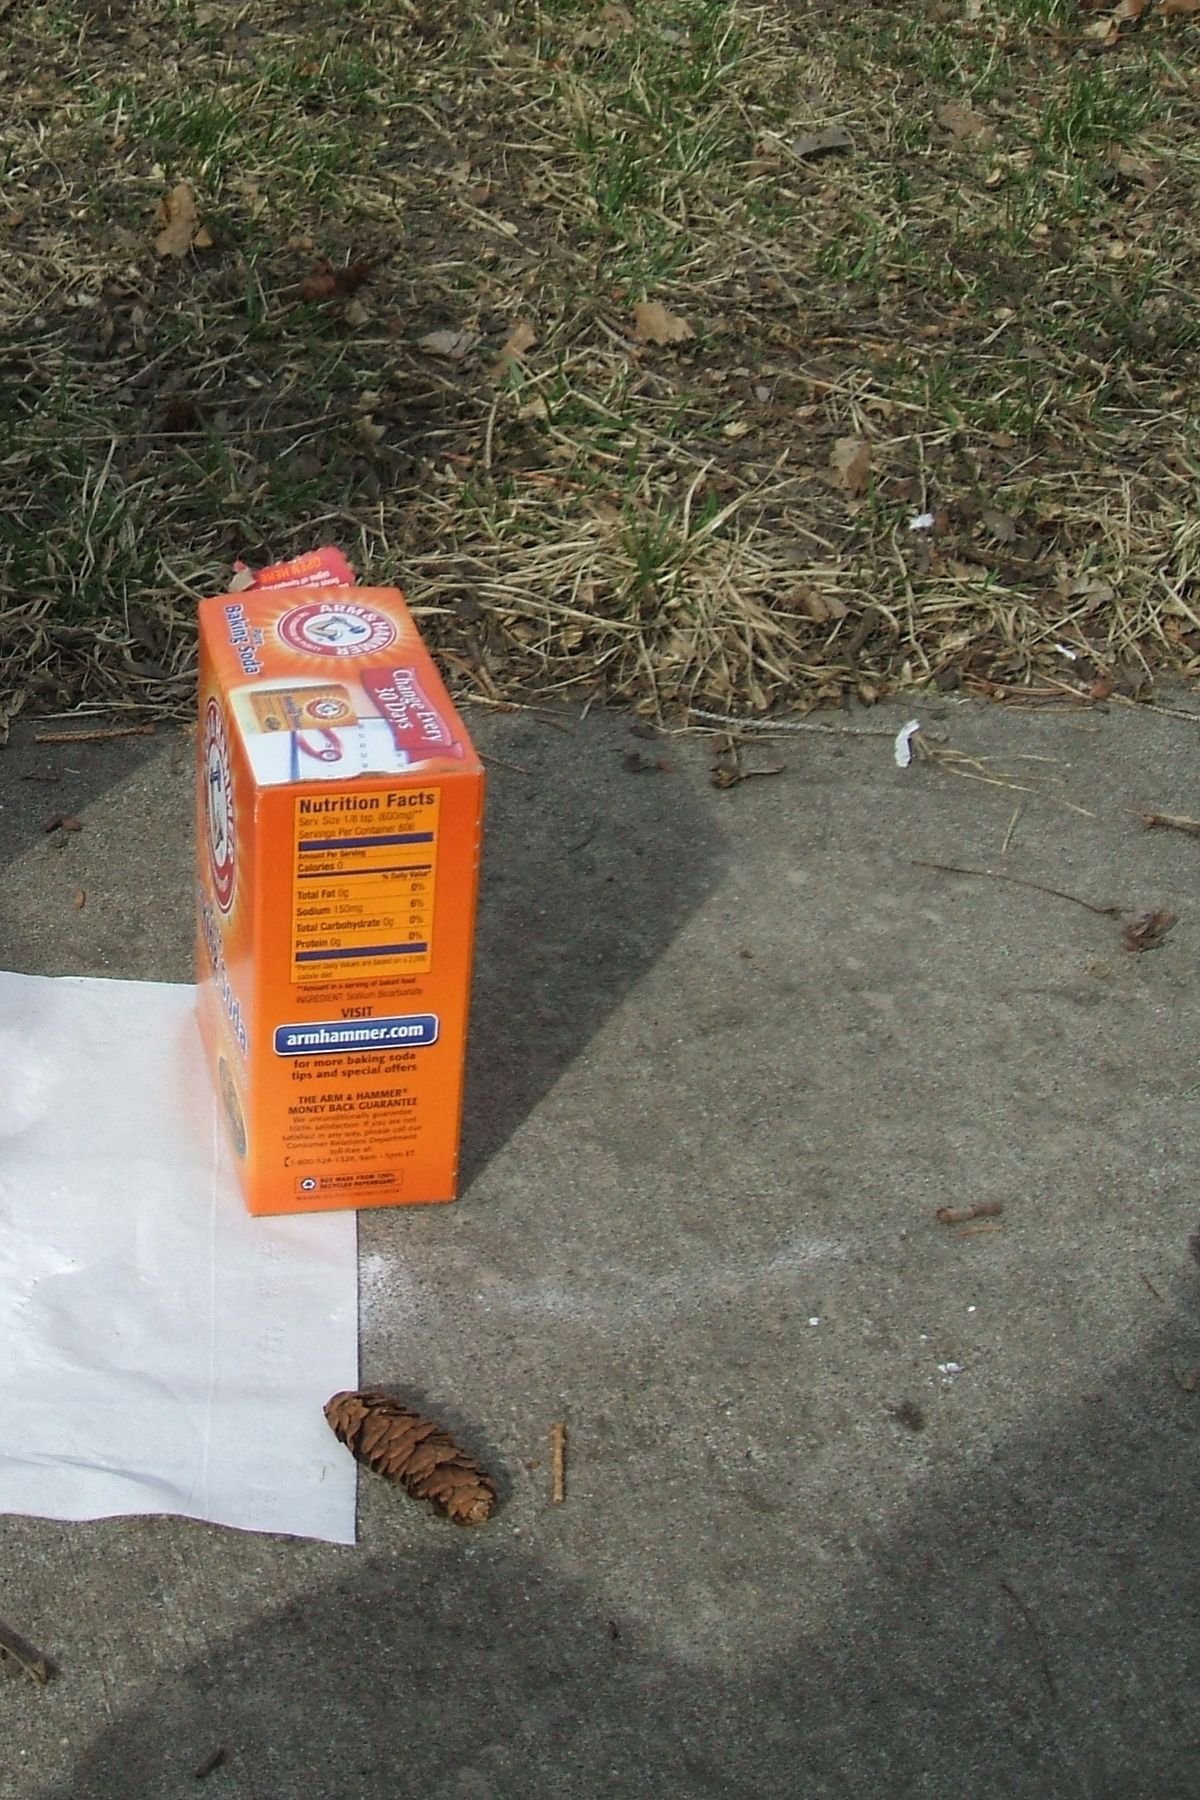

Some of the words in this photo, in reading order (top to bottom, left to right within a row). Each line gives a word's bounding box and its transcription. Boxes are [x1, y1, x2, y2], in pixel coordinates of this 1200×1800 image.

[320, 604, 364, 615] ARM
[362, 613, 377, 622] &
[224, 604, 249, 645] Baking
[238, 645, 263, 674] Soda
[336, 621, 391, 655] HAMMER
[374, 687, 399, 700] 30
[393, 669, 425, 709] Change
[416, 711, 443, 741] Every
[384, 703, 413, 729] Days
[299, 797, 379, 813] Nutrition
[387, 792, 435, 807] Facts
[323, 814, 341, 825] Size
[299, 828, 337, 840] Servings
[339, 827, 353, 837] Per
[355, 824, 396, 836] Container
[298, 851, 326, 860] Amount
[327, 850, 338, 858] Per
[340, 849, 366, 858] Serving
[298, 861, 334, 872] Calories
[337, 861, 344, 870] 0
[297, 889, 319, 900] Total
[321, 889, 336, 898] Fat
[338, 888, 349, 899] 0g
[411, 882, 426, 892] 0%
[296, 906, 331, 917] Sodium
[335, 903, 363, 914] 150mg
[297, 922, 318, 933] Total
[320, 918, 381, 931] Carbohydrate
[383, 916, 394, 928] 0g
[409, 914, 424, 925] 0%
[295, 938, 328, 949] Protein
[329, 937, 341, 948] 0g
[408, 931, 423, 941] 0%
[341, 1006, 373, 1018] VISIT
[287, 1024, 424, 1046] armhammer.com
[293, 1059, 311, 1069] for
[313, 1058, 343, 1067] more
[347, 1055, 386, 1065] baking
[389, 1051, 416, 1061] soda
[291, 1070, 313, 1082] tips
[316, 1068, 338, 1079] and
[341, 1065, 381, 1078] special
[384, 1062, 417, 1074] offers
[288, 1104, 327, 1115] MONEY
[328, 1102, 355, 1113] BACK
[358, 1097, 418, 1110] GUARANTEE
[298, 1095, 317, 1105] THE
[319, 1094, 344, 1103] ARM
[346, 1093, 353, 1101] &
